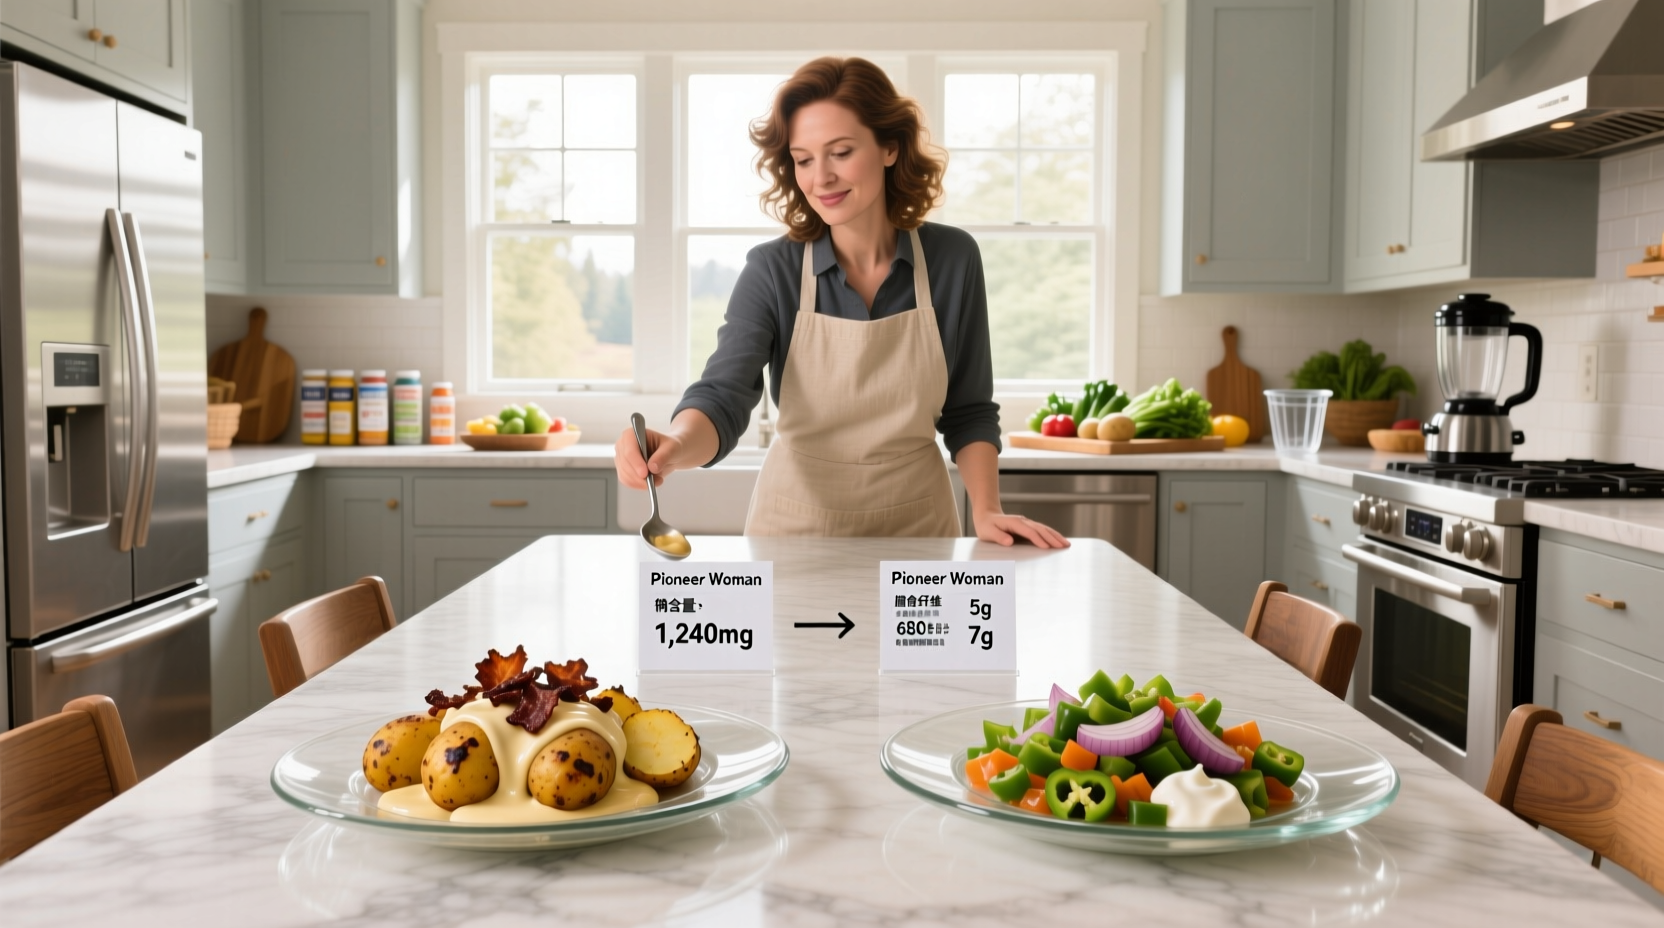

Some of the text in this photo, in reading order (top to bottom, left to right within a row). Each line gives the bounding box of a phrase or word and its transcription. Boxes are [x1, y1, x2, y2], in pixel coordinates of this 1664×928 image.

[650, 572, 762, 586] Pioneer Woman
[891, 571, 1004, 585] Pioneer Woman
[969, 598, 992, 620] 5g
[655, 622, 753, 650] 1,240mg
[968, 625, 993, 650] 7g
